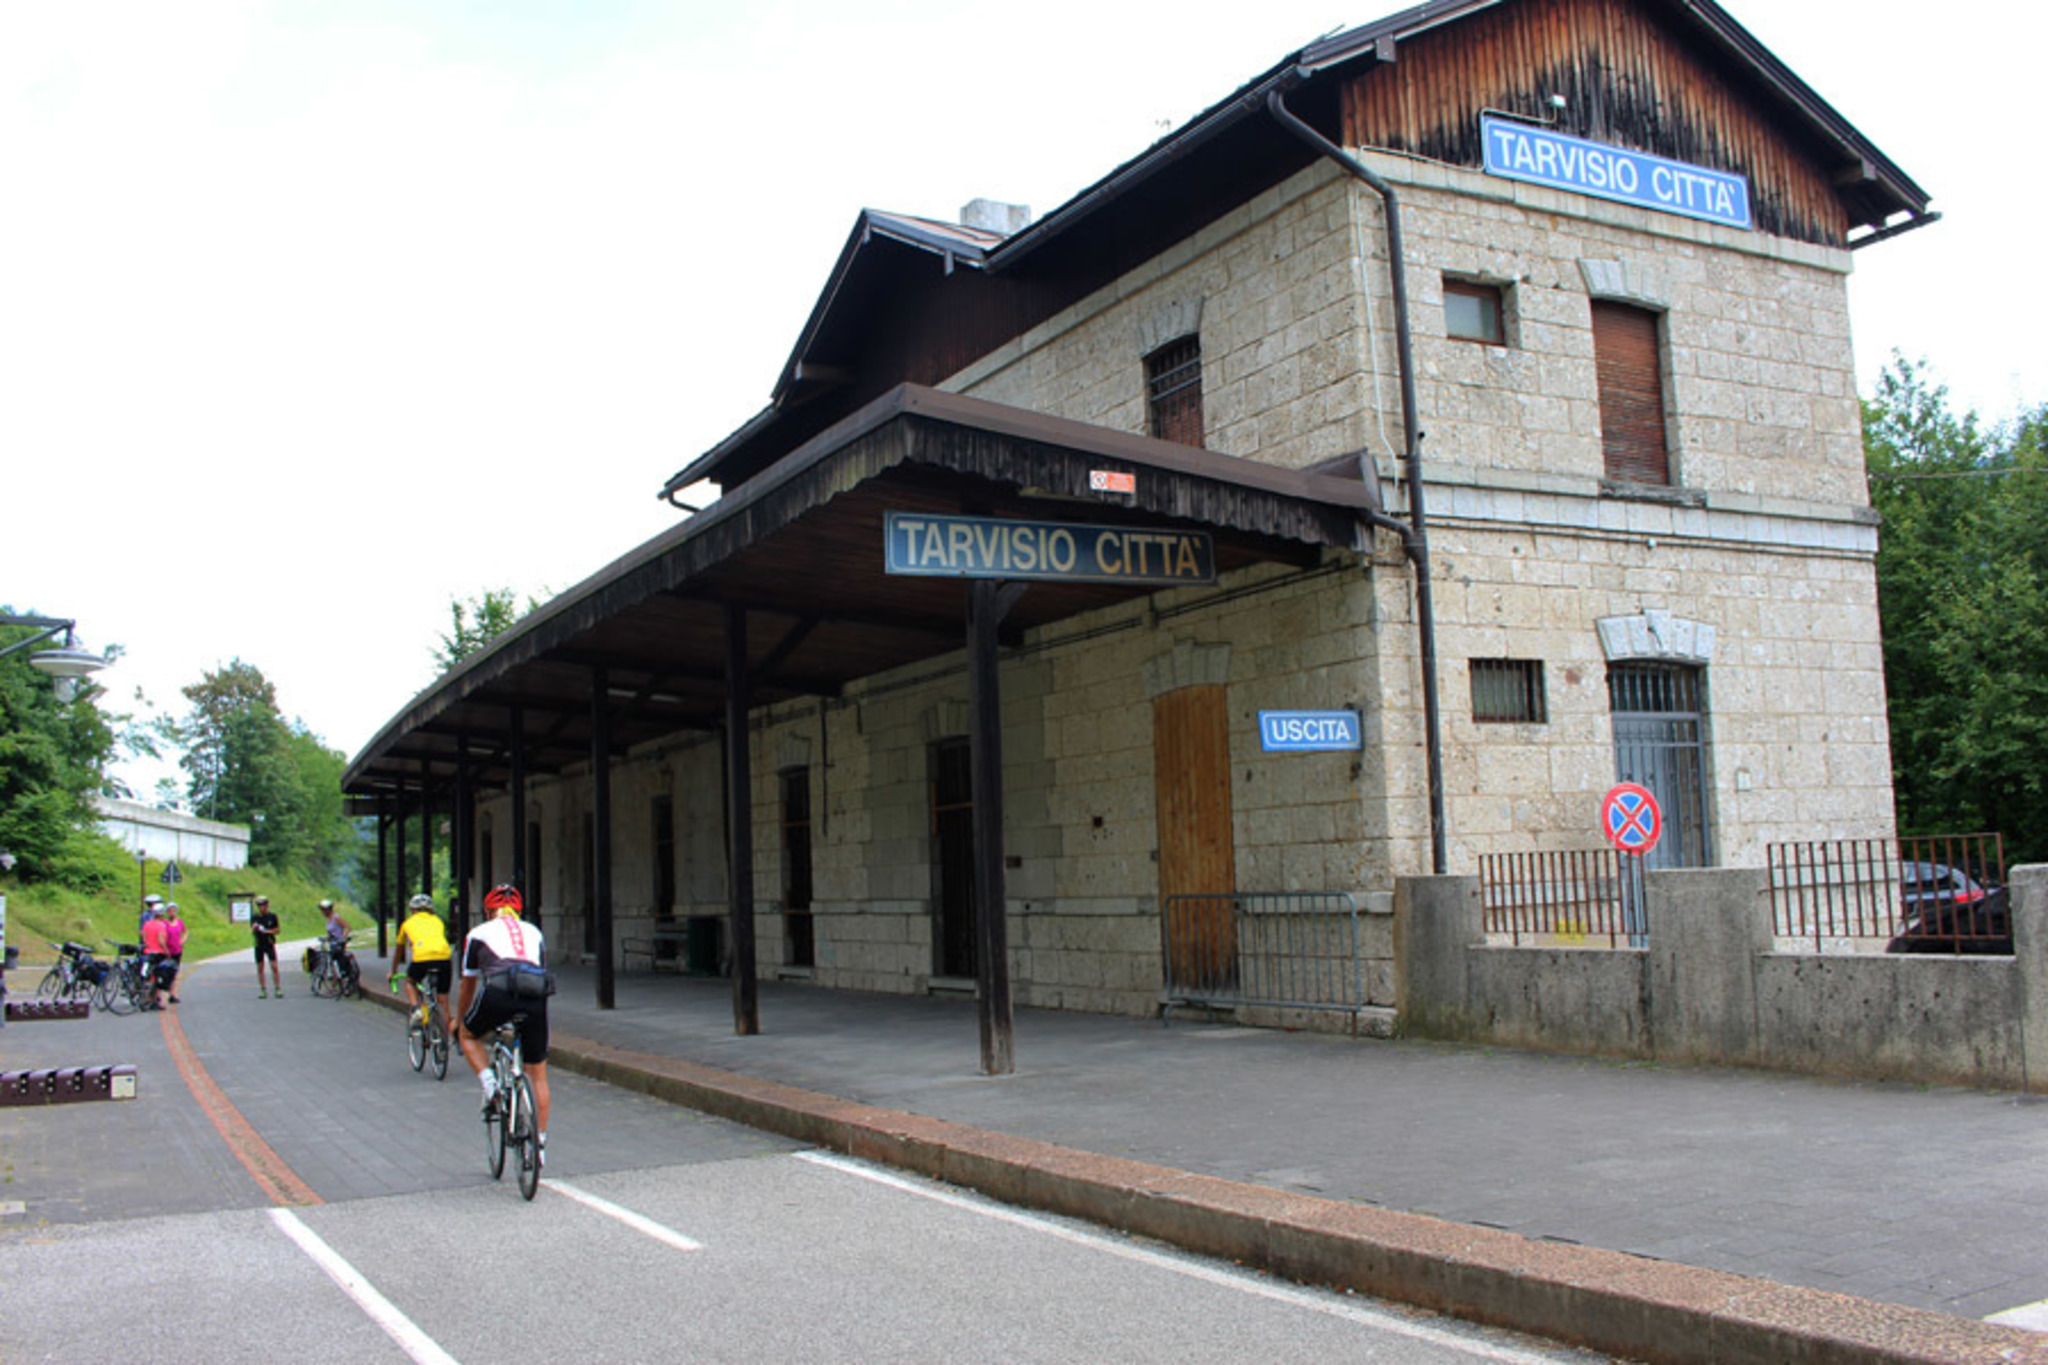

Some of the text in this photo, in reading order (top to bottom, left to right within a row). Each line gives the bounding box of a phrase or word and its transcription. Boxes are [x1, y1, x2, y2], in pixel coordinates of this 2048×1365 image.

[1493, 129, 1638, 193] TARVISIO
[898, 520, 1076, 572] TARVISIO
[1271, 719, 1351, 741] USCITA
